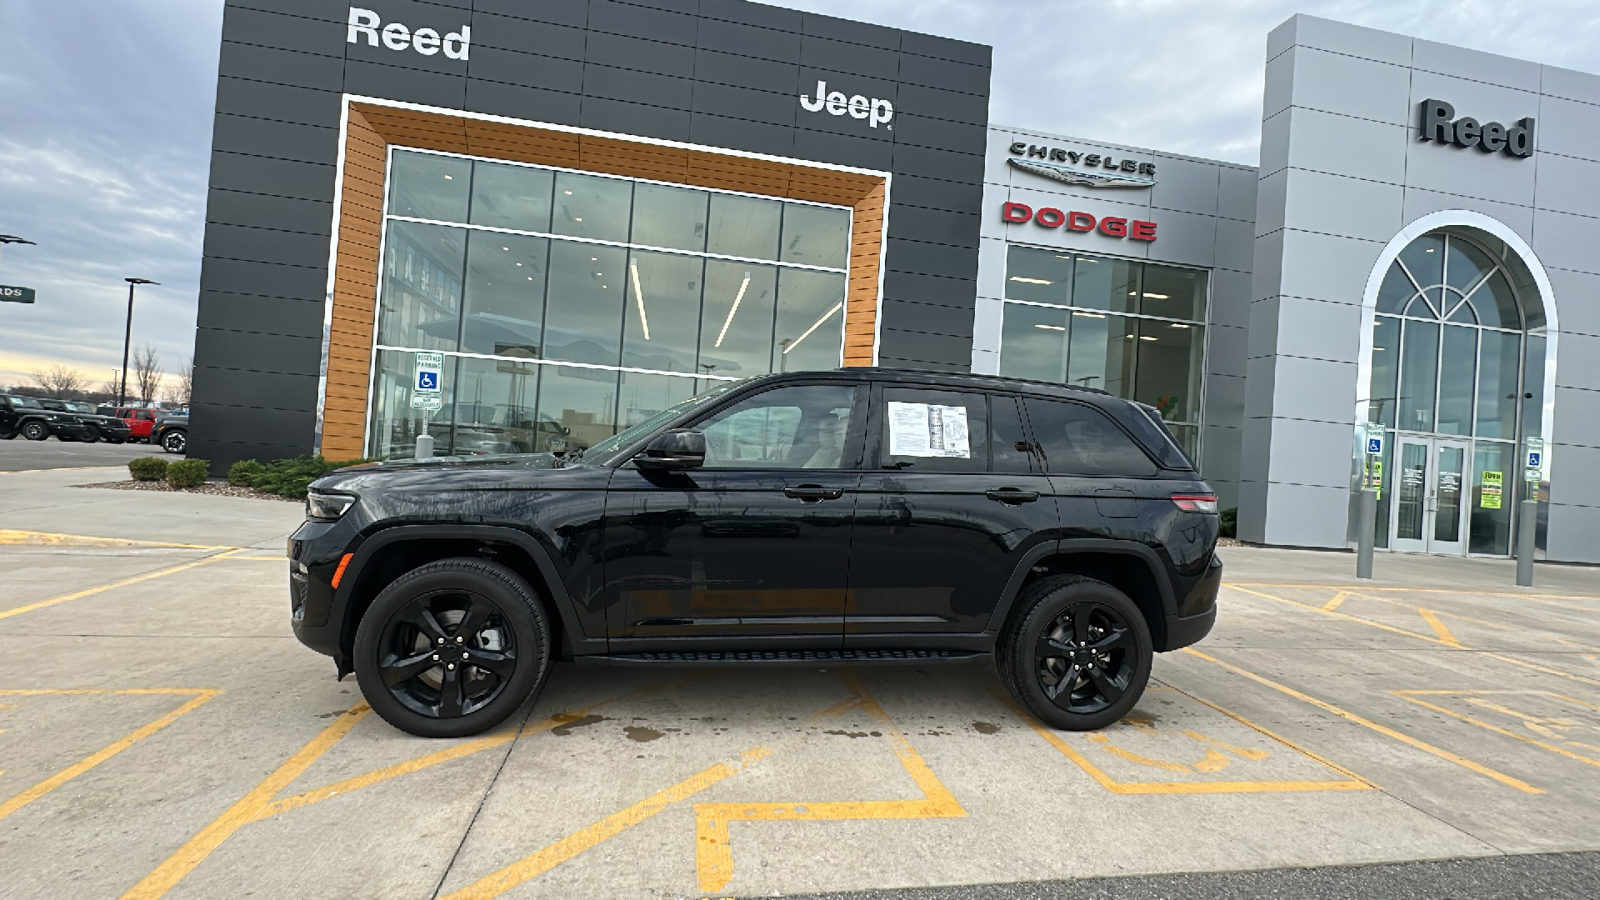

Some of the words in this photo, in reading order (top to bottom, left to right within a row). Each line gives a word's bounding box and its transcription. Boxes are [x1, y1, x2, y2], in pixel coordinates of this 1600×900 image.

[347, 6, 471, 61] Reed
[800, 80, 893, 129] Jeep
[1420, 98, 1536, 158] Reed
[1009, 141, 1157, 176] CHRYSLER
[1002, 201, 1158, 242] DODGE
